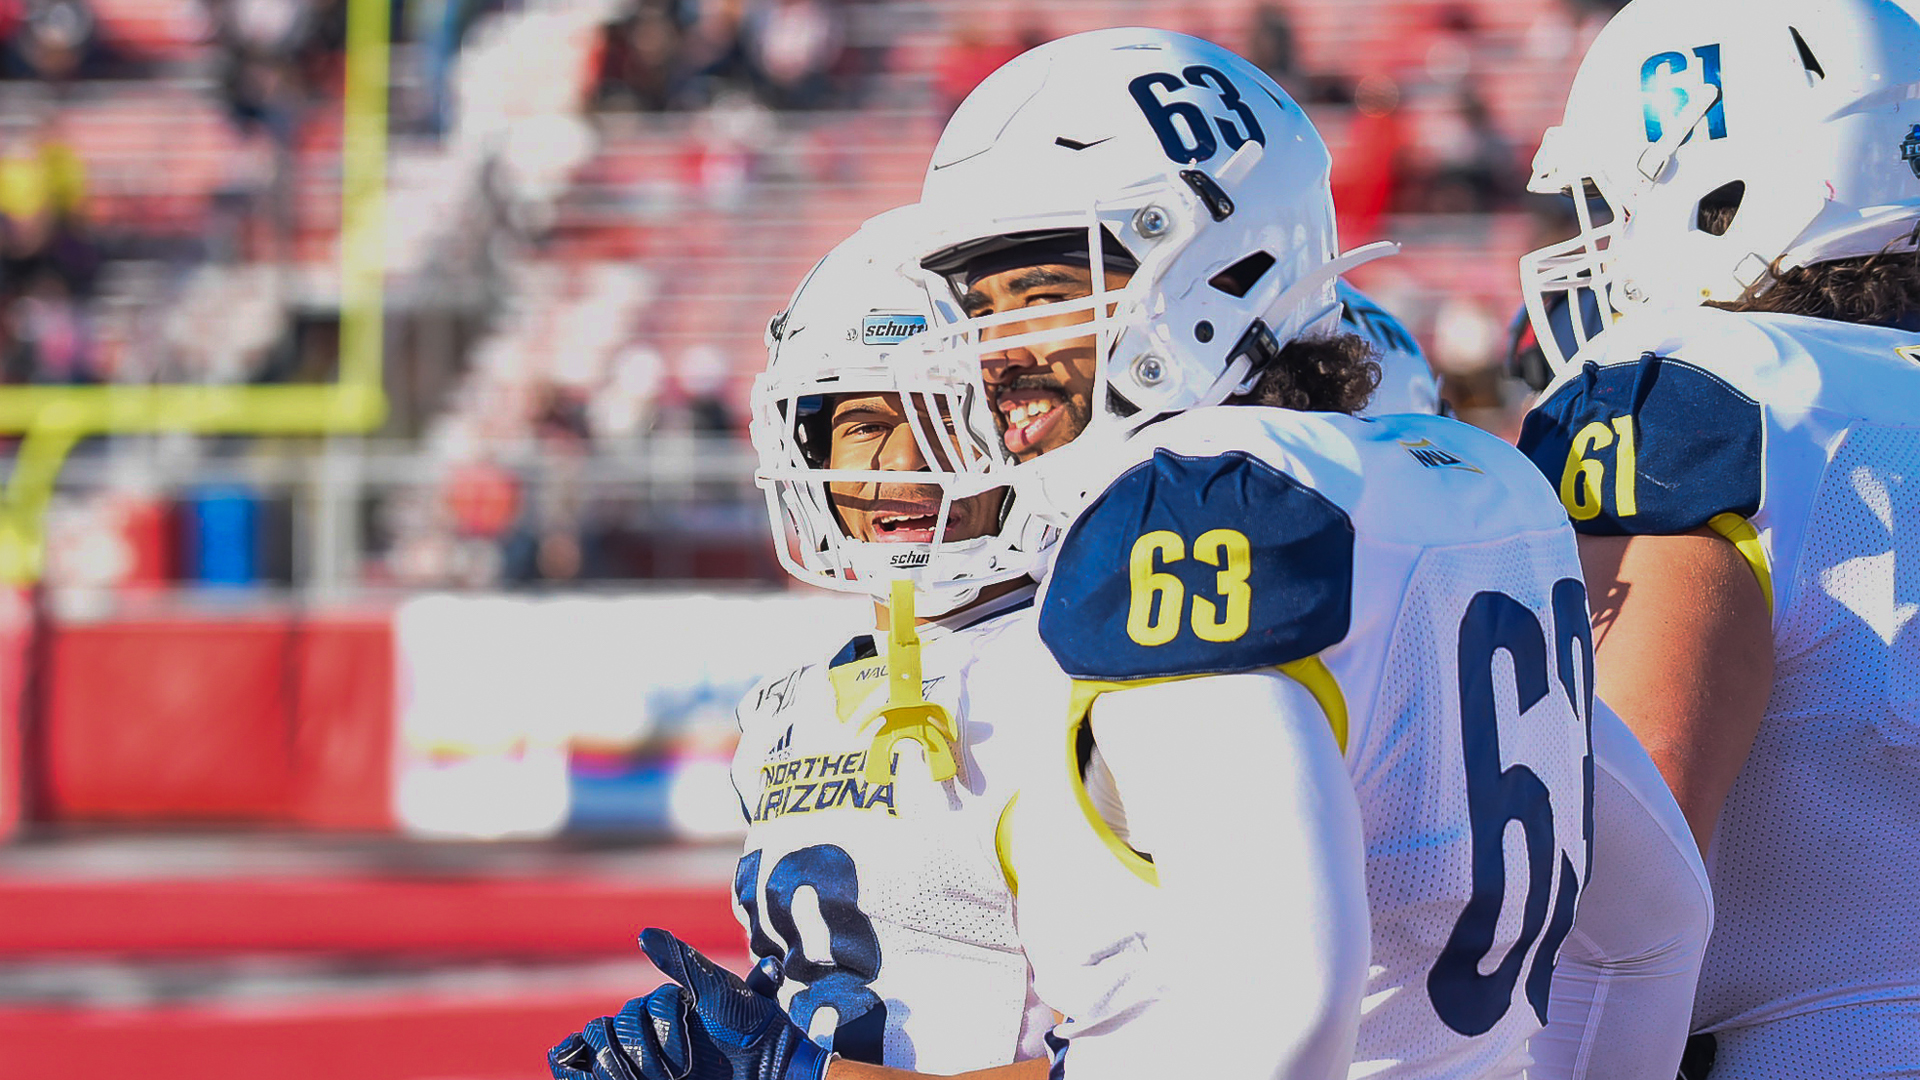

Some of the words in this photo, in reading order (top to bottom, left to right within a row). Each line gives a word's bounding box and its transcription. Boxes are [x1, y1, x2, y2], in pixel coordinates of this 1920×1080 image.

[1128, 64, 1266, 164] 63
[1640, 43, 1727, 143] 61
[865, 320, 926, 338] schutt
[1560, 414, 1637, 520] 61
[1127, 528, 1251, 646] 63
[764, 750, 899, 788] NORTHE
